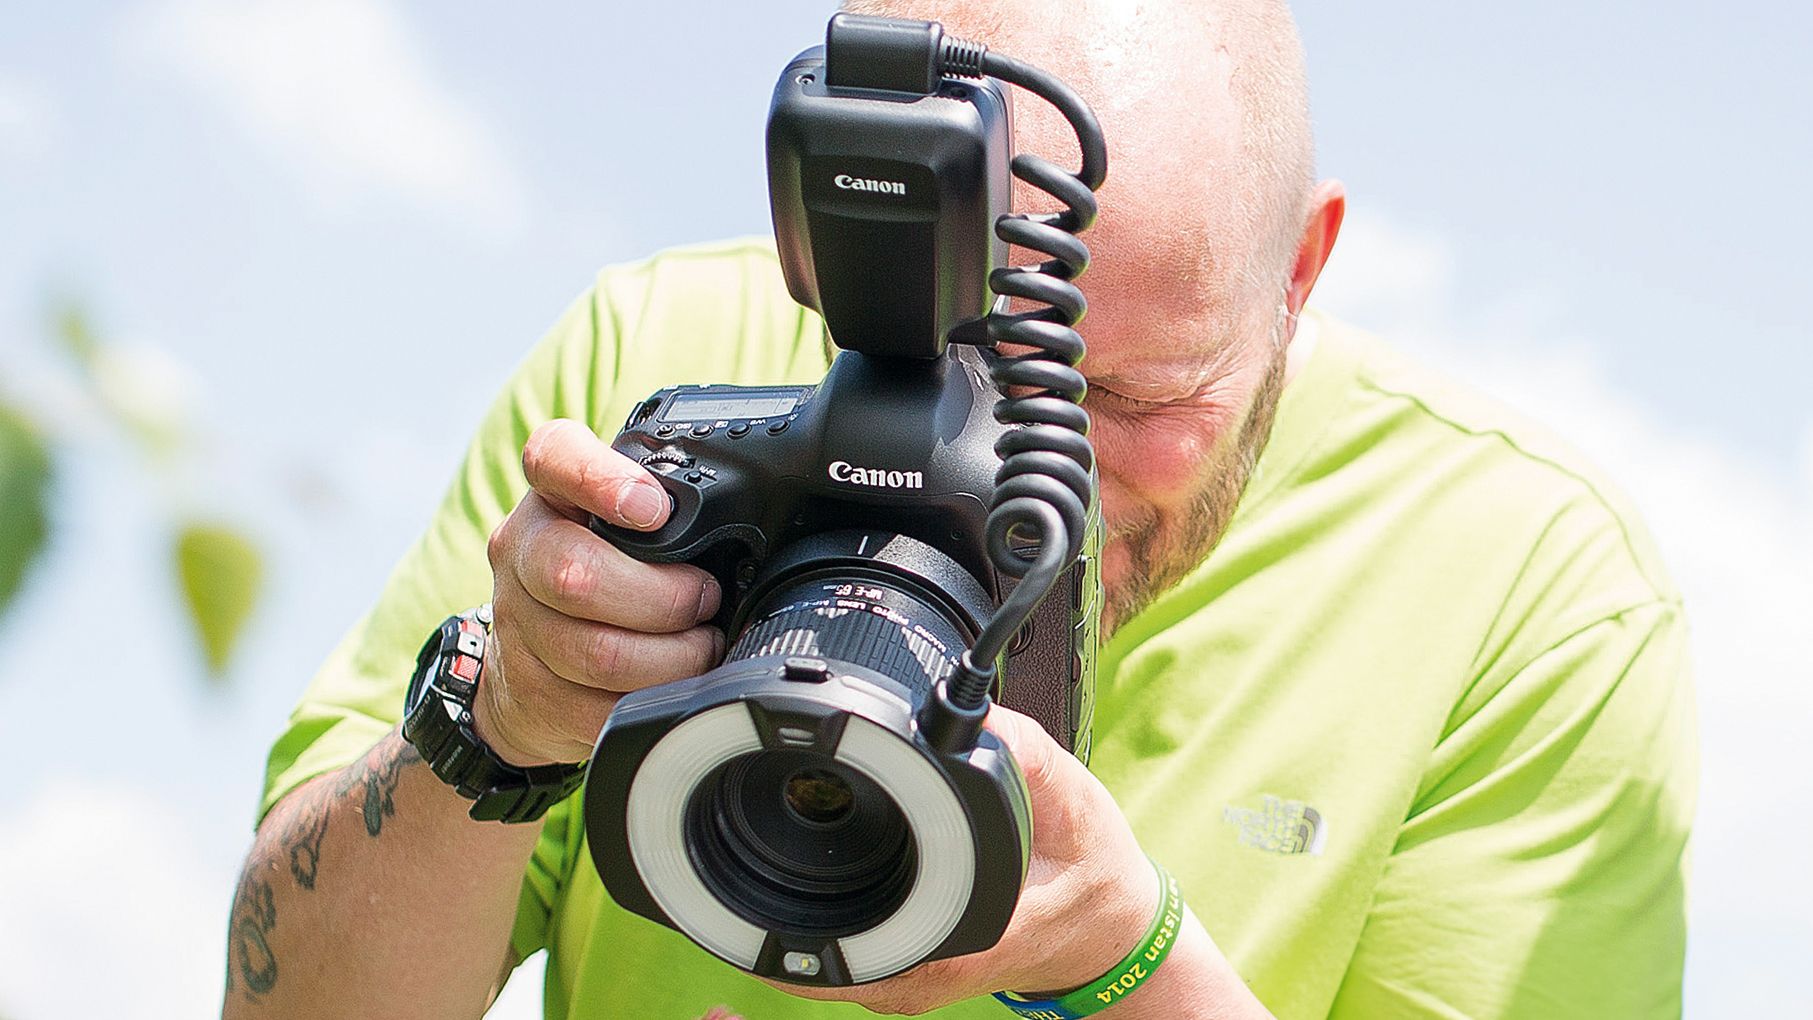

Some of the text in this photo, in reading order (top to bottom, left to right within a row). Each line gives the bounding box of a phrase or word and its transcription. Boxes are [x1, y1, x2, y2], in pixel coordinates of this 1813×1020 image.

[834, 174, 906, 195] Canon
[828, 461, 923, 489] Canon
[855, 585, 883, 600] MP-E
[914, 624, 947, 653] MACRO
[1096, 962, 1148, 1004] 2014
